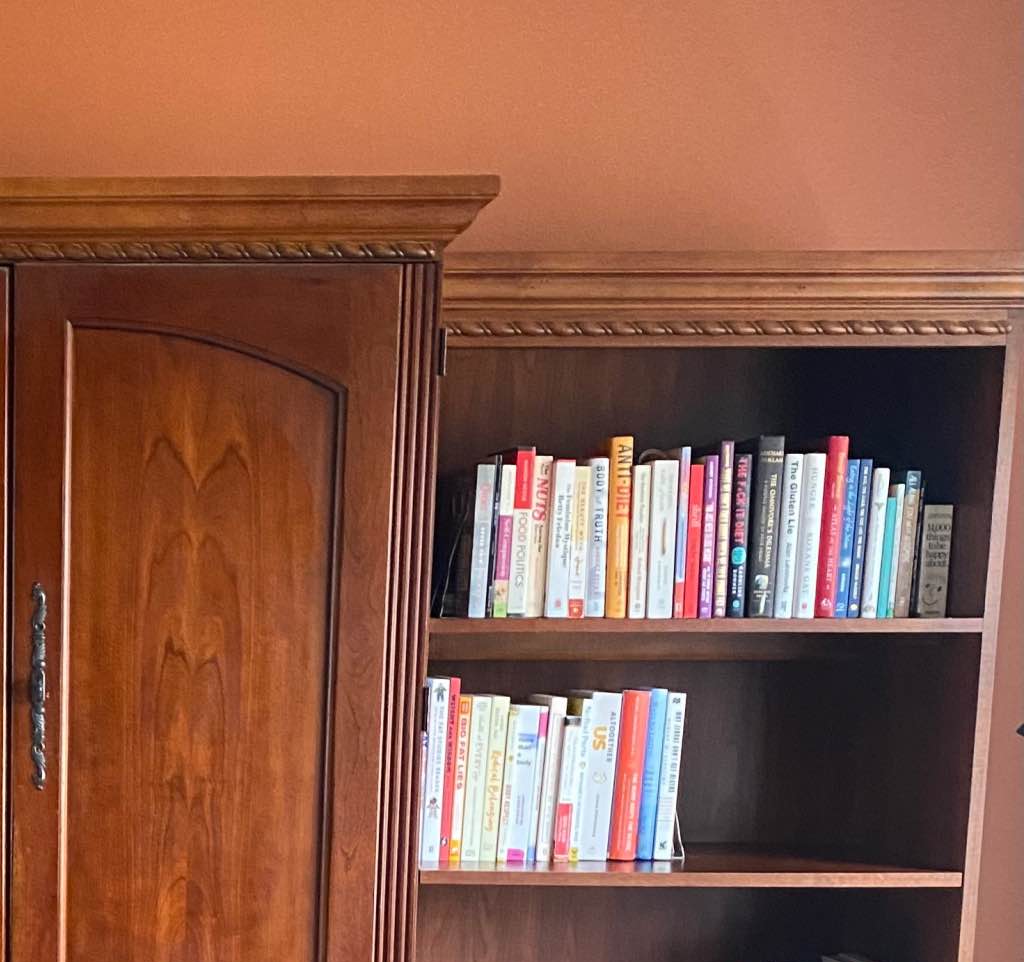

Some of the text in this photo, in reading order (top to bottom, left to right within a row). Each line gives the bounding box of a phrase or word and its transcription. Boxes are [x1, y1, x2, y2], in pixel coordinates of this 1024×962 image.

[616, 444, 632, 519] ANTI-DIET
[737, 457, 748, 478] THE
[532, 478, 549, 521] NUTS
[594, 465, 605, 542] BODY TRUTH
[736, 508, 745, 518] IT
[767, 489, 776, 534] OMNIVORE'S
[787, 461, 799, 535] The Gluten Lie
[515, 512, 528, 588] FOOD POLITICS
[734, 521, 744, 544] DIET
[764, 535, 773, 569] DILEMMA
[826, 558, 835, 583] HEART
[592, 725, 607, 751] US
[606, 712, 616, 763] ALTOGETHER
[456, 764, 464, 790] LIES
